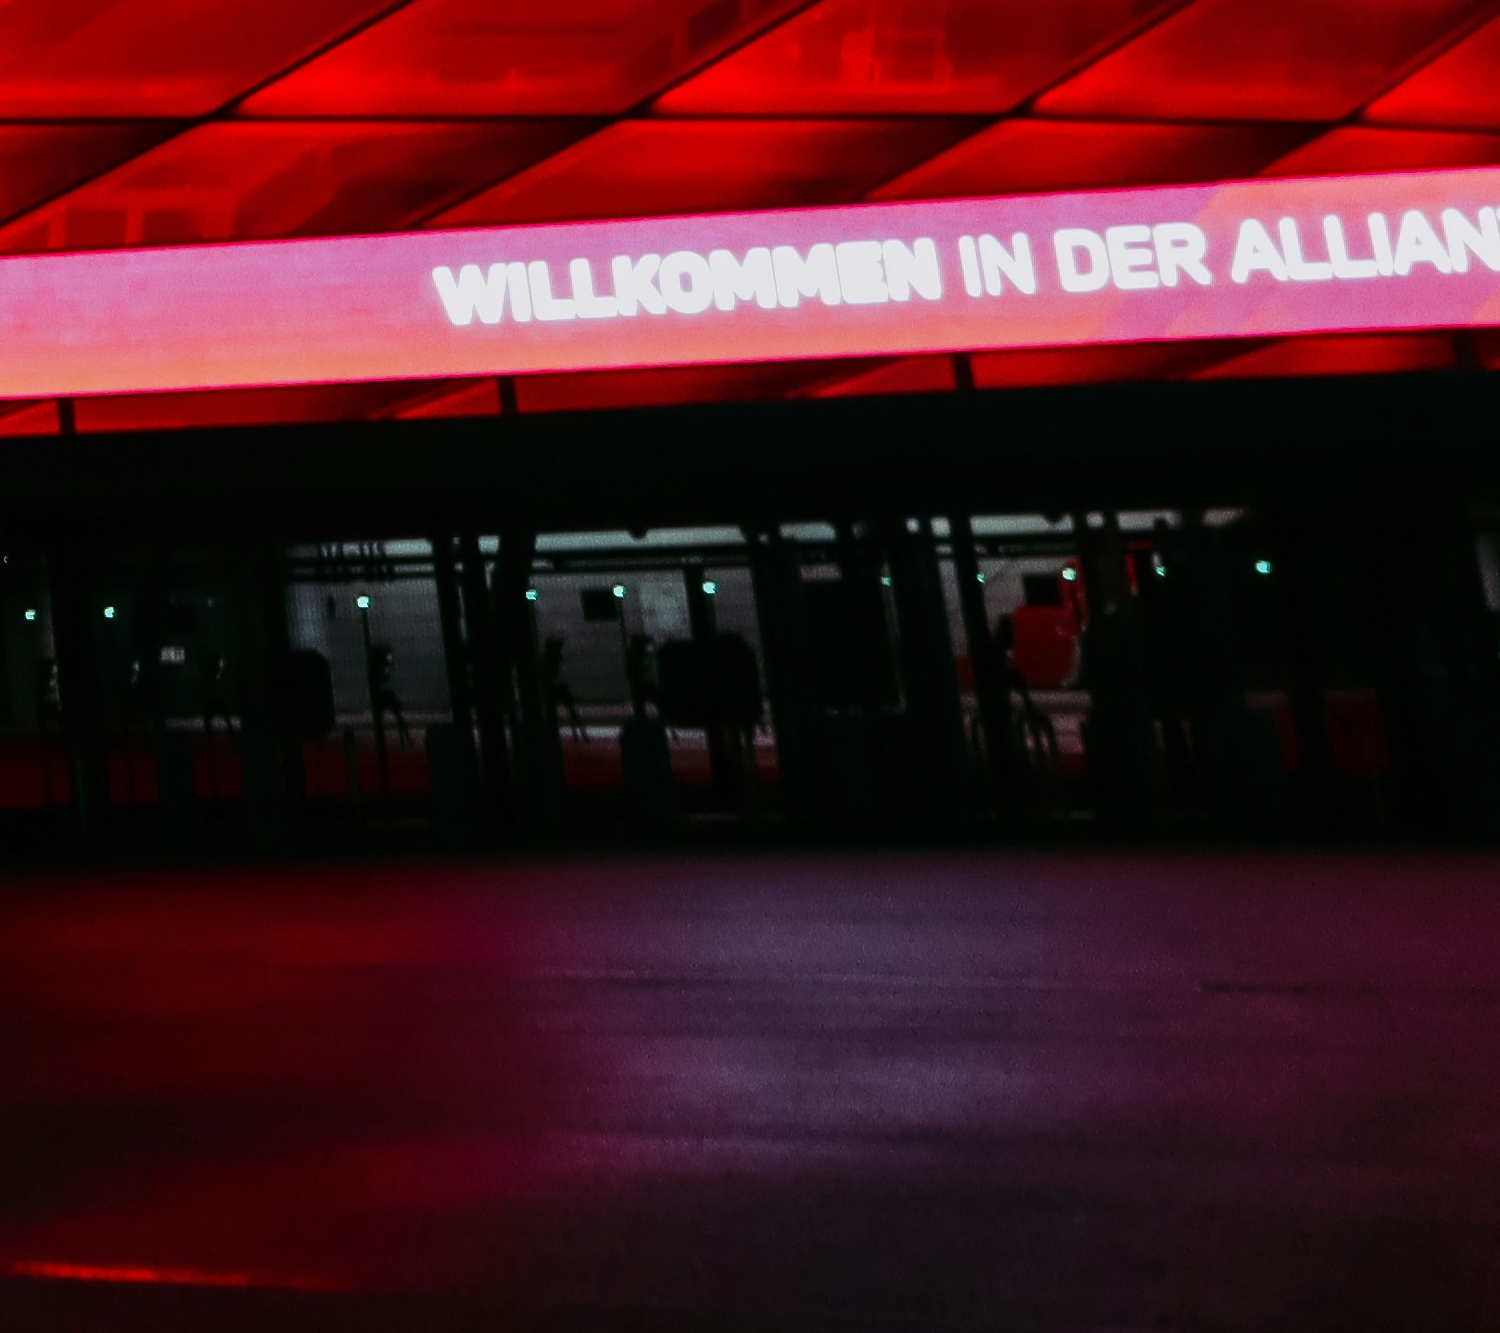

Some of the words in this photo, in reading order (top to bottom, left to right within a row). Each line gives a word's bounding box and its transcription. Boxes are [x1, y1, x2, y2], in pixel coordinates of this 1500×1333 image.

[431, 237, 943, 326] WILLKOMMEN
[958, 232, 1037, 299] IN
[1053, 222, 1212, 293] DER
[1231, 206, 1500, 284] ALLIAN
